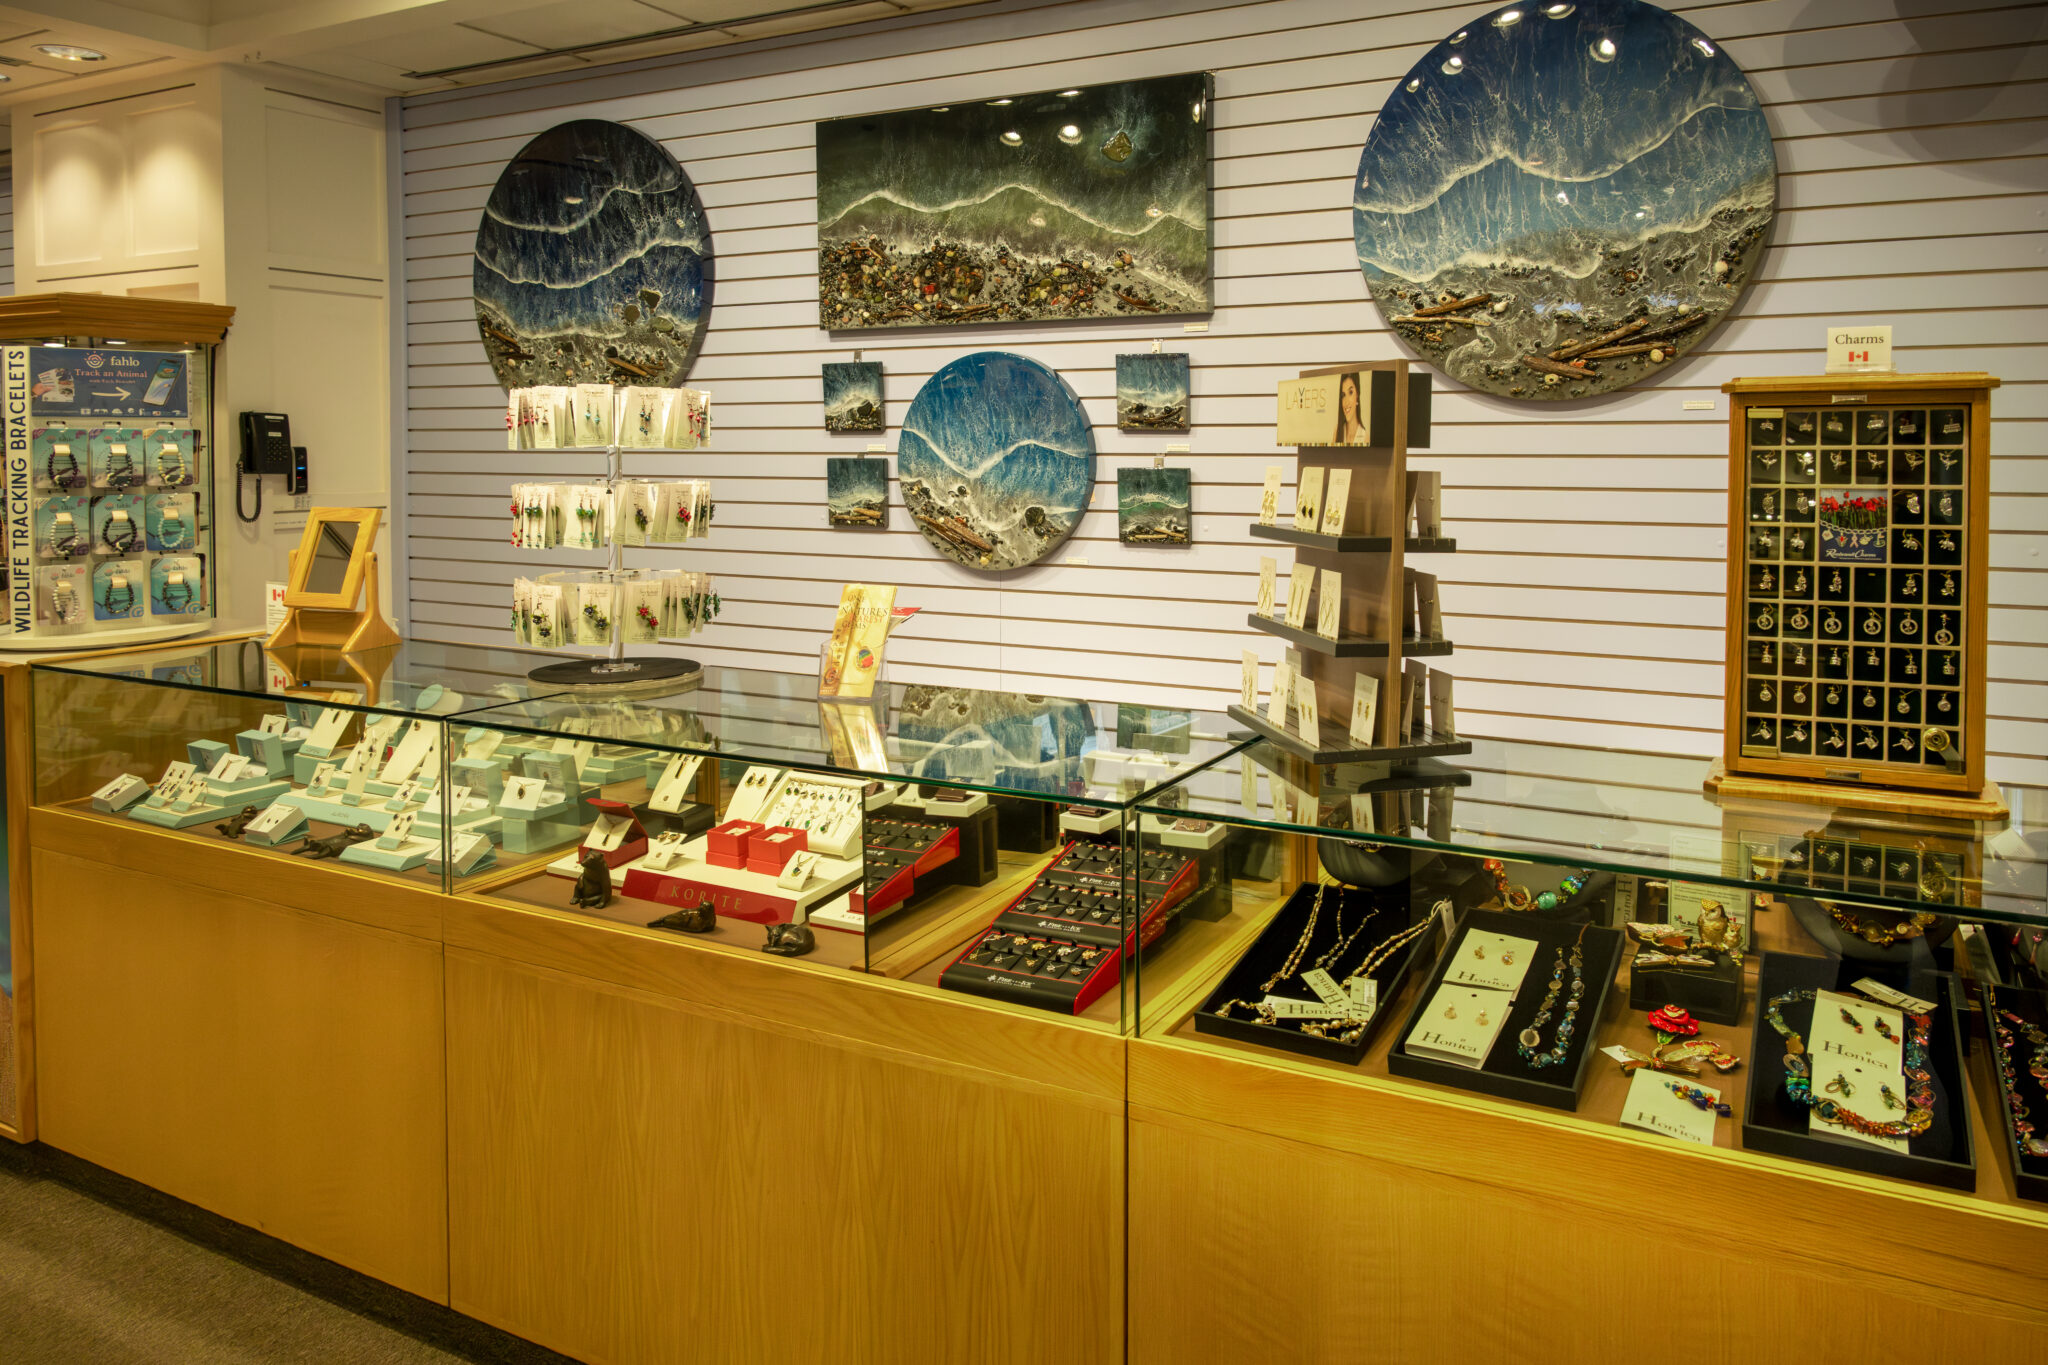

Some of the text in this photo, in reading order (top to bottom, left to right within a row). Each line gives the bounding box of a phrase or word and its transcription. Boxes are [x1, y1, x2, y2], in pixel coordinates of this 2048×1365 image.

[1834, 333, 1885, 345] Charms
[110, 356, 140, 367] fahlo
[74, 368, 101, 377] Track
[116, 370, 148, 378] Animal
[1285, 387, 1327, 410] LAYERS
[8, 350, 31, 633] WILDLIFE TRACKING BRACELETS
[671, 885, 742, 911] KORITE
[1458, 970, 1510, 988] Honica
[1422, 1031, 1477, 1053] Honica
[1823, 1040, 1889, 1070] Honica
[1637, 1111, 1701, 1142] Honica
